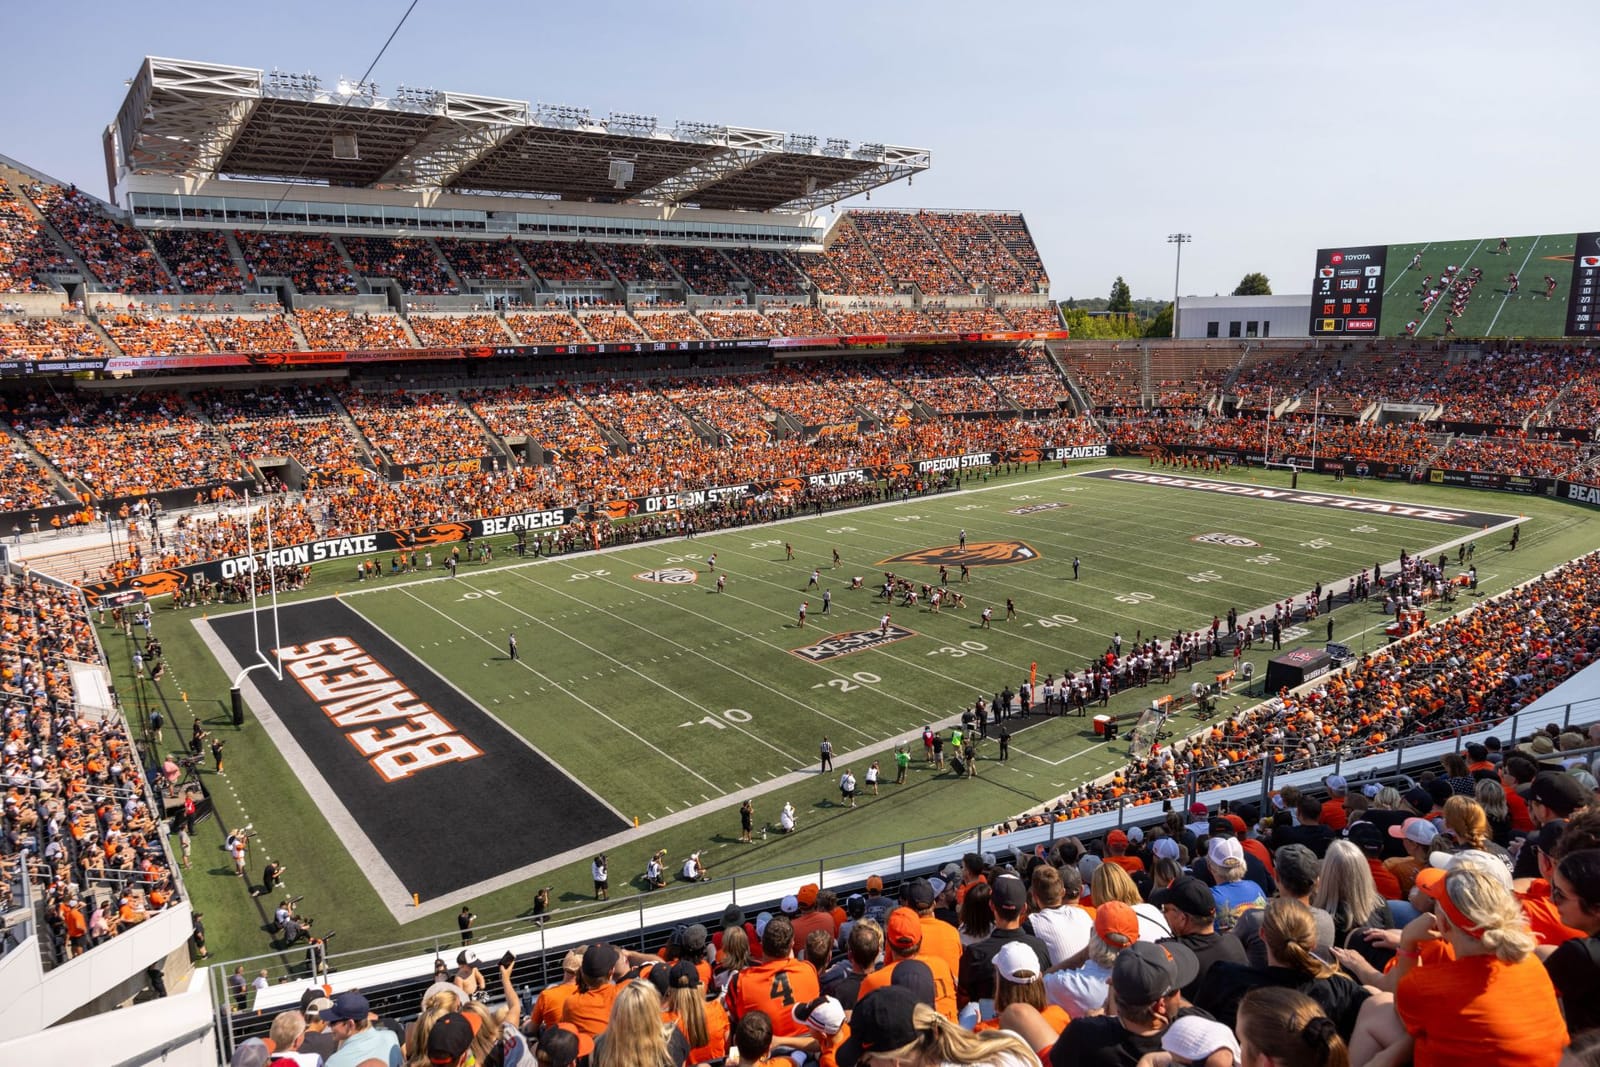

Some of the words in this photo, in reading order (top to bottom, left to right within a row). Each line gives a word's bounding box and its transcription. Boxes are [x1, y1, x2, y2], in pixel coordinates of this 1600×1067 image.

[1322, 279, 1330, 290] 3
[1368, 278, 1376, 289] 0
[1323, 304, 1336, 314] 1ST
[919, 457, 960, 472] OREGON
[961, 453, 992, 467] STATE
[1056, 446, 1107, 459] BEAVERS
[1110, 473, 1293, 498] OREGON
[1297, 495, 1468, 521] STATE
[482, 510, 564, 536] BEAVERS
[314, 534, 378, 560] STATE
[1114, 592, 1156, 605] 50
[1038, 614, 1078, 628] 40
[800, 626, 908, 658] RESER
[940, 641, 988, 658] 30
[828, 672, 882, 693] 20
[271, 636, 486, 783] BEAVERS
[698, 708, 753, 730] 10
[770, 972, 796, 1007] 4
